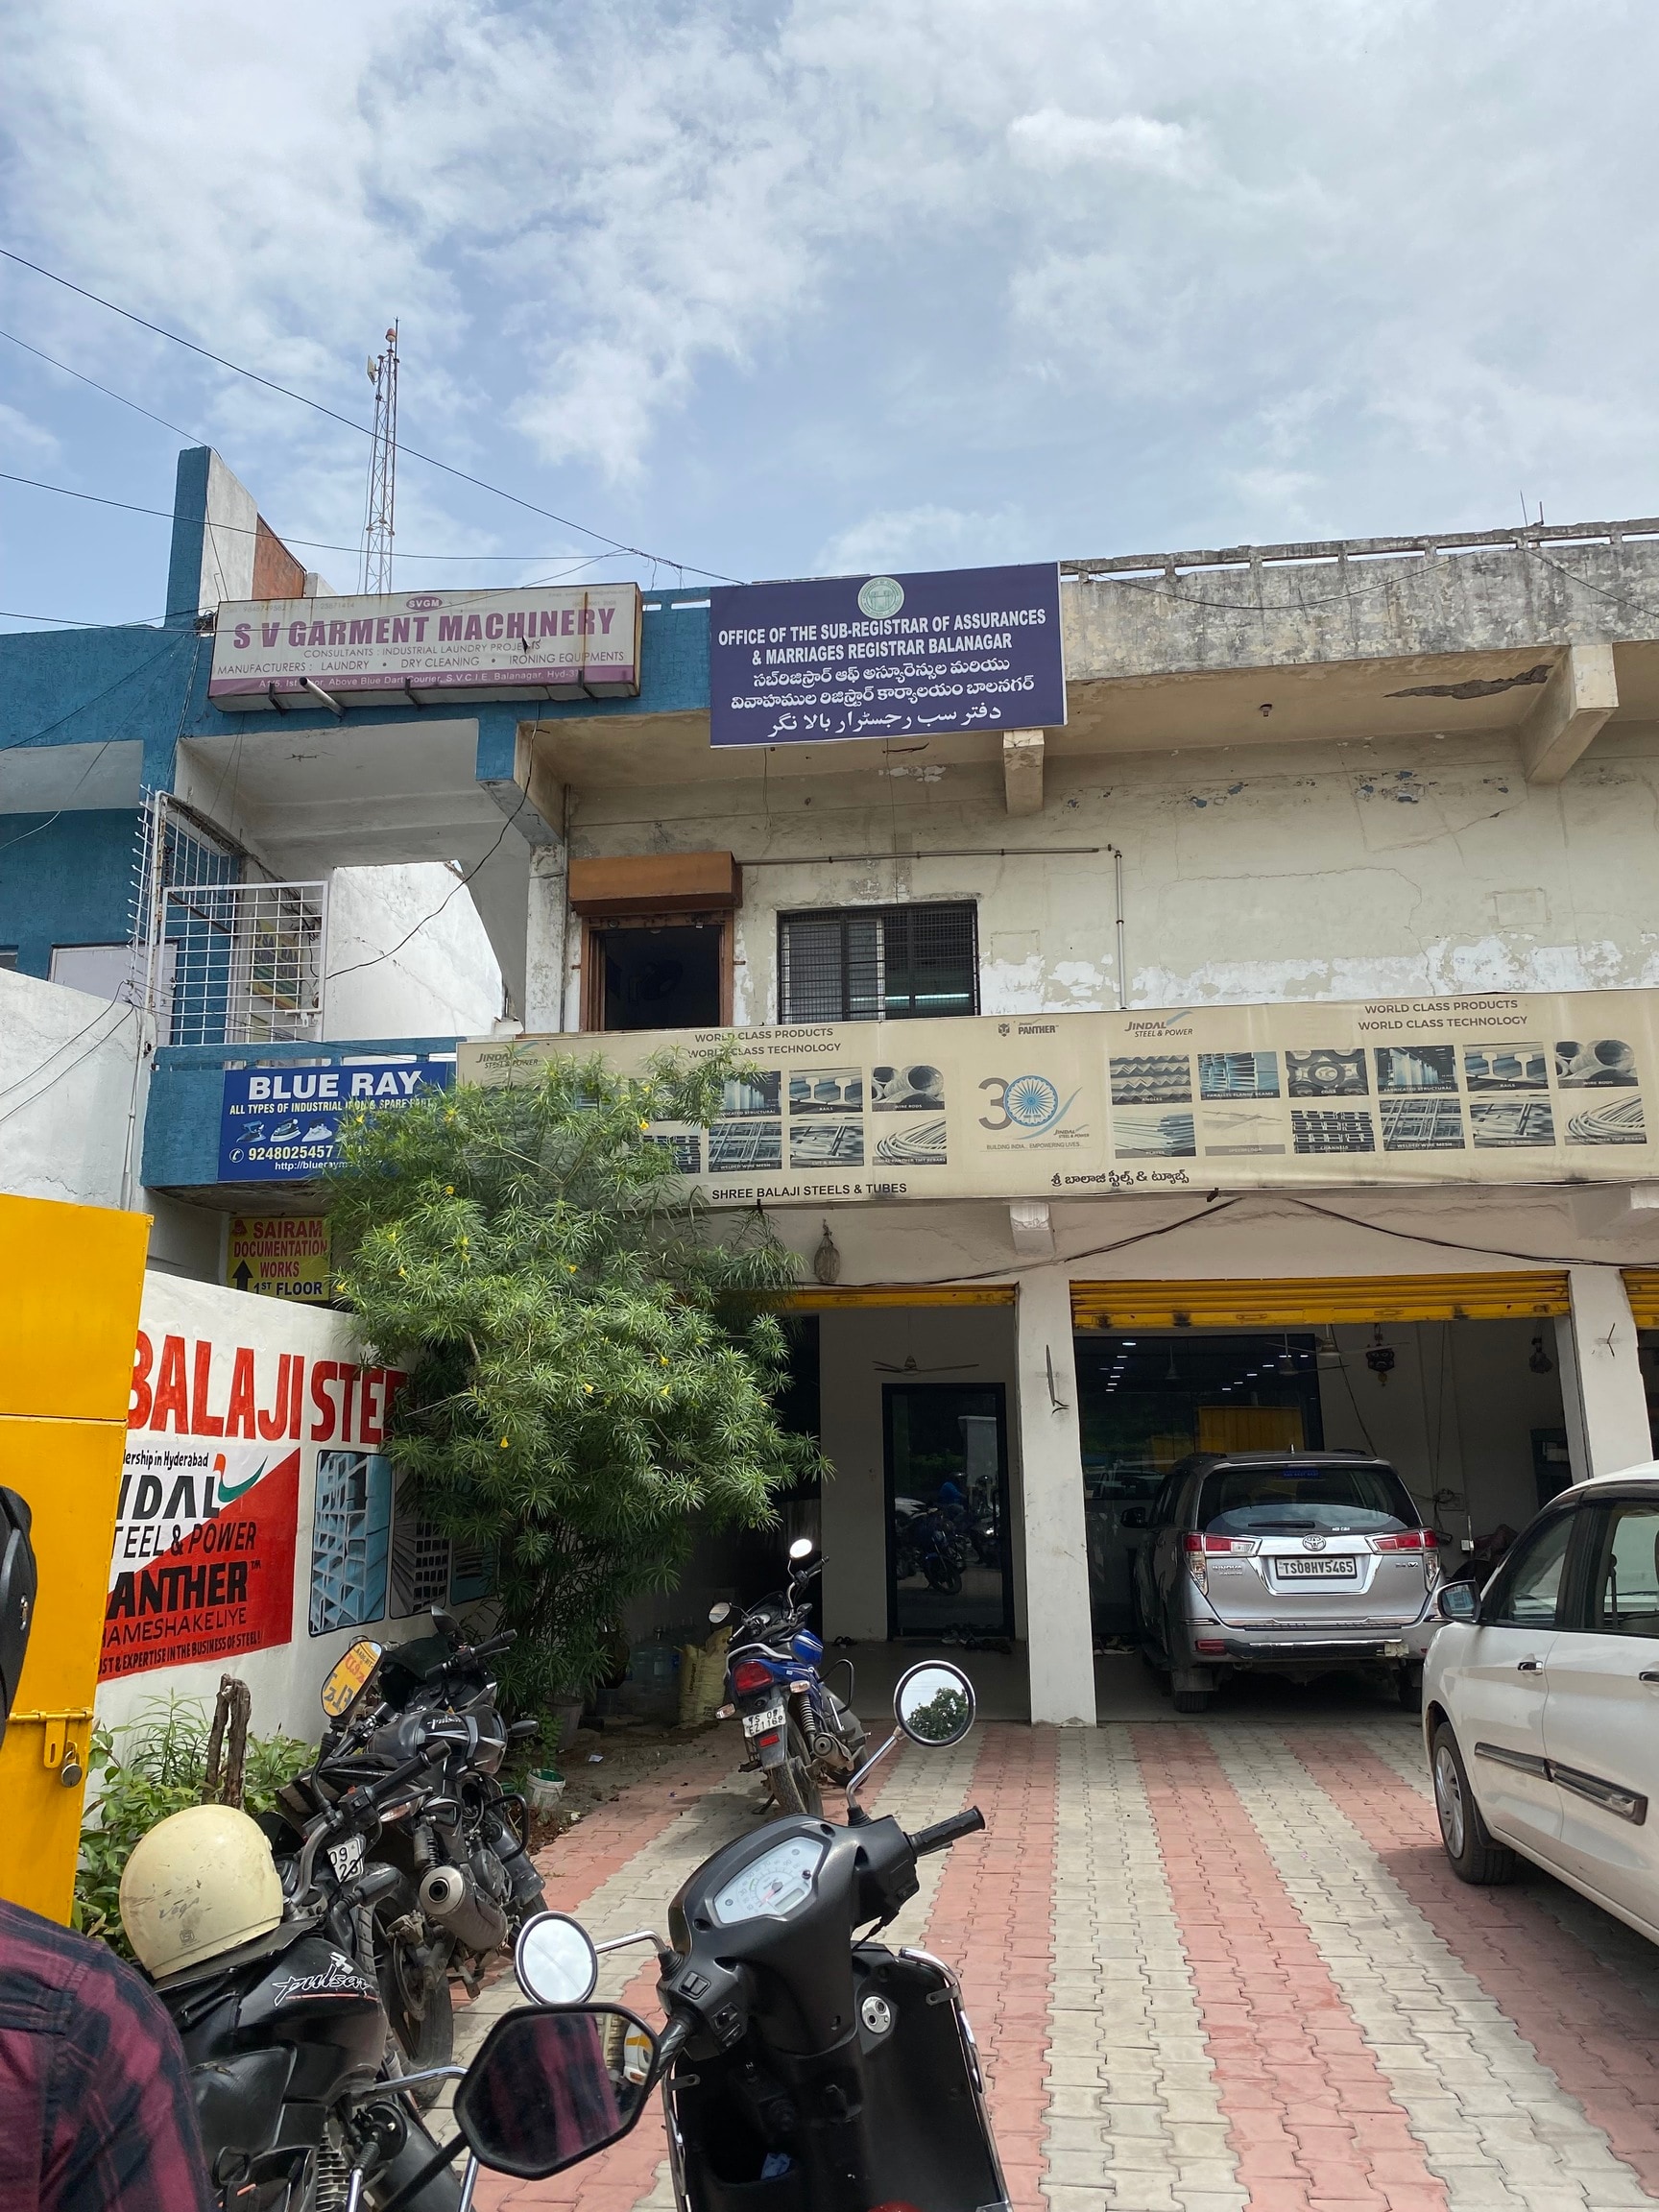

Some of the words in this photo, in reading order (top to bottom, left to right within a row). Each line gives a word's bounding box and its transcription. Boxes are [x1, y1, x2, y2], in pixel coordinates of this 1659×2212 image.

[408, 597, 441, 610] SVGM
[233, 623, 251, 649] S
[261, 622, 280, 648] V
[288, 616, 429, 647] GARMENT
[439, 608, 616, 641] MACHINERY
[718, 629, 765, 645] OFFICE
[769, 627, 787, 643] OF
[790, 625, 817, 641] THE
[820, 617, 929, 640] SUB-REGISTRAR
[932, 615, 950, 632] OF
[953, 609, 1046, 631] ASSURANCES
[303, 647, 373, 659] CONSULTANTS
[382, 644, 438, 656] INDUSTRIAL
[441, 643, 487, 654] LAUNDRY
[752, 649, 762, 665] &
[766, 644, 845, 664] MARRIAGES
[848, 637, 925, 660] REGISTRAR
[928, 633, 1013, 654] BALANAGAR
[217, 661, 306, 674] MANUFACTURERS
[321, 661, 370, 671] LAUNDRY
[401, 659, 421, 668] DRY
[424, 656, 480, 667] CLEANING
[509, 653, 556, 664] IRONING
[559, 651, 624, 663] EQUIPMENTS
[835, 666, 860, 683] ఆఫ్
[950, 658, 1010, 674] మరియు
[328, 677, 358, 686] Above
[361, 676, 381, 685] Blue
[384, 675, 404, 685] Dart
[731, 692, 817, 709] వివాహముల
[877, 683, 964, 704] కార్యాలయం
[917, 709, 957, 727] سب
[960, 703, 1001, 726] دفتر
[1364, 1003, 1409, 1014] WORLD
[1412, 1002, 1451, 1012] CLASS
[1454, 999, 1519, 1011] PRODUCTS
[1019, 1024, 1056, 1035] PANTHER
[1124, 1021, 1167, 1032] JINDAL
[1358, 1020, 1404, 1030] WORLD
[1406, 1019, 1444, 1028] CLASS
[1447, 1016, 1528, 1027] TECHNOLOGY
[737, 1030, 772, 1041] CLASS
[775, 1027, 833, 1039] PRODUCTS
[476, 1052, 512, 1063] JINDA
[732, 1046, 765, 1057] CLASS
[768, 1043, 842, 1055] TECHNOLOGY
[248, 1072, 340, 1101] BLUE
[350, 1070, 422, 1096] RAY
[229, 1104, 246, 1116] ALL
[248, 1103, 275, 1115] TYPES
[277, 1102, 289, 1114] OF
[291, 1100, 343, 1113] INDUSTRIAL
[379, 1098, 407, 1109] SPARE
[248, 1144, 334, 1161] 9248025457
[1136, 1170, 1147, 1182] &
[711, 1188, 753, 1199] SHREE
[757, 1186, 800, 1198] BALAJI
[803, 1184, 850, 1196] STEELS
[854, 1184, 863, 1194] &
[865, 1183, 907, 1194] TUBES
[252, 1220, 323, 1238] SAIRAM
[233, 1239, 327, 1258] DOCUMENTATION
[260, 1261, 300, 1278] WORKS
[276, 1281, 323, 1296] FLOOR
[127, 1330, 305, 1440] BALAJI
[155, 1451, 162, 1465] in
[164, 1451, 209, 1470] Hyderabad
[110, 1525, 164, 1560] TEEL
[170, 1525, 183, 1556] &
[188, 1521, 257, 1554] POWER
[1284, 1559, 1354, 1575] TS08HV5465
[106, 1560, 248, 1621] ANTHER
[122, 1649, 166, 1671] EXPERTISE
[176, 1643, 191, 1660] THE
[192, 1638, 227, 1657] BUSINESS
